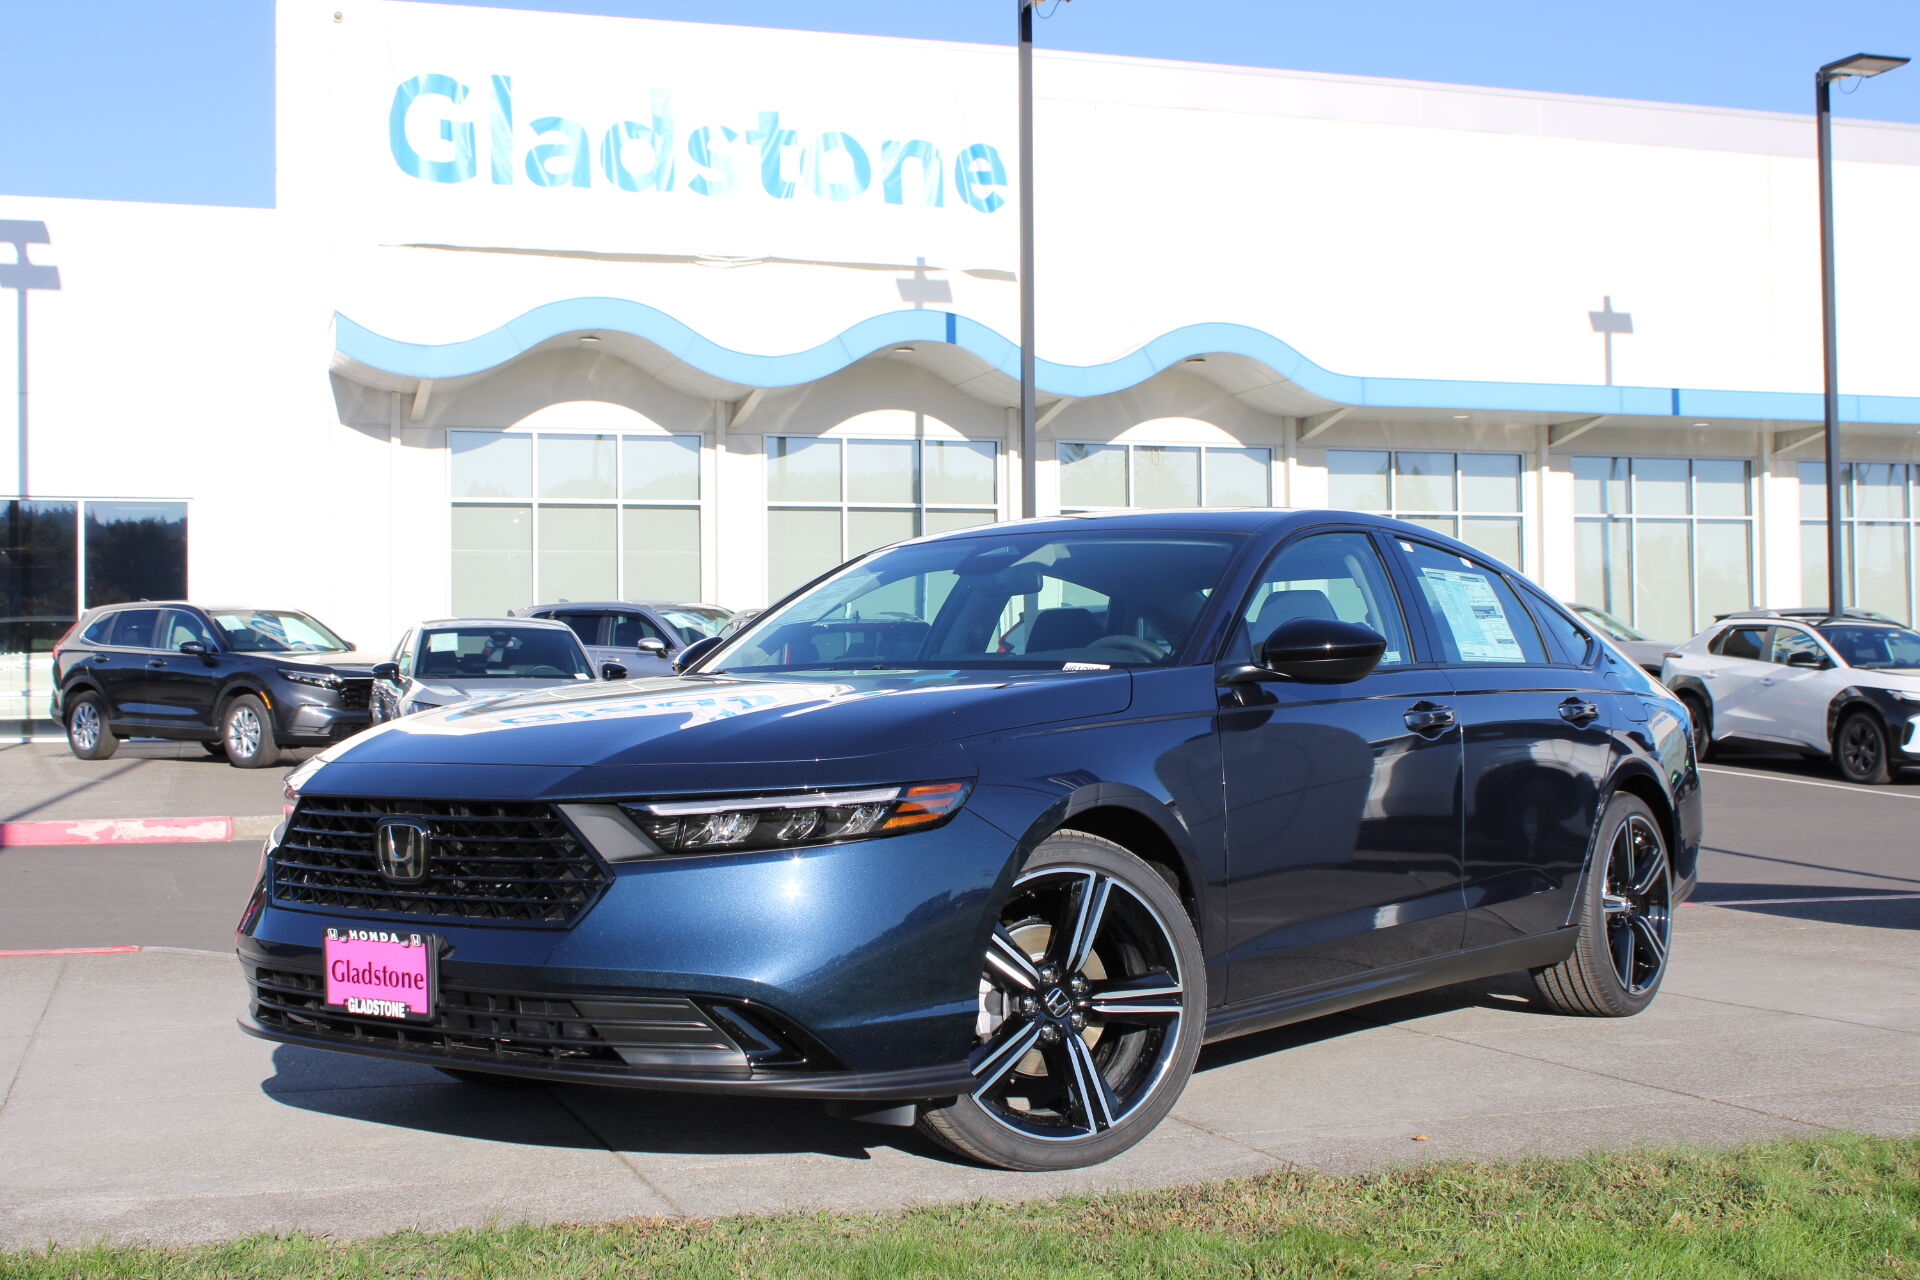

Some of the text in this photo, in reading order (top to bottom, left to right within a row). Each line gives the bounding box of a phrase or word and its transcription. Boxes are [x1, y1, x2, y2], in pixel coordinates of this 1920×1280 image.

[388, 72, 1008, 213] Gladstone
[348, 929, 400, 944] HONDA
[331, 959, 425, 990] Gladstone
[347, 997, 405, 1018] GLADSTONE
